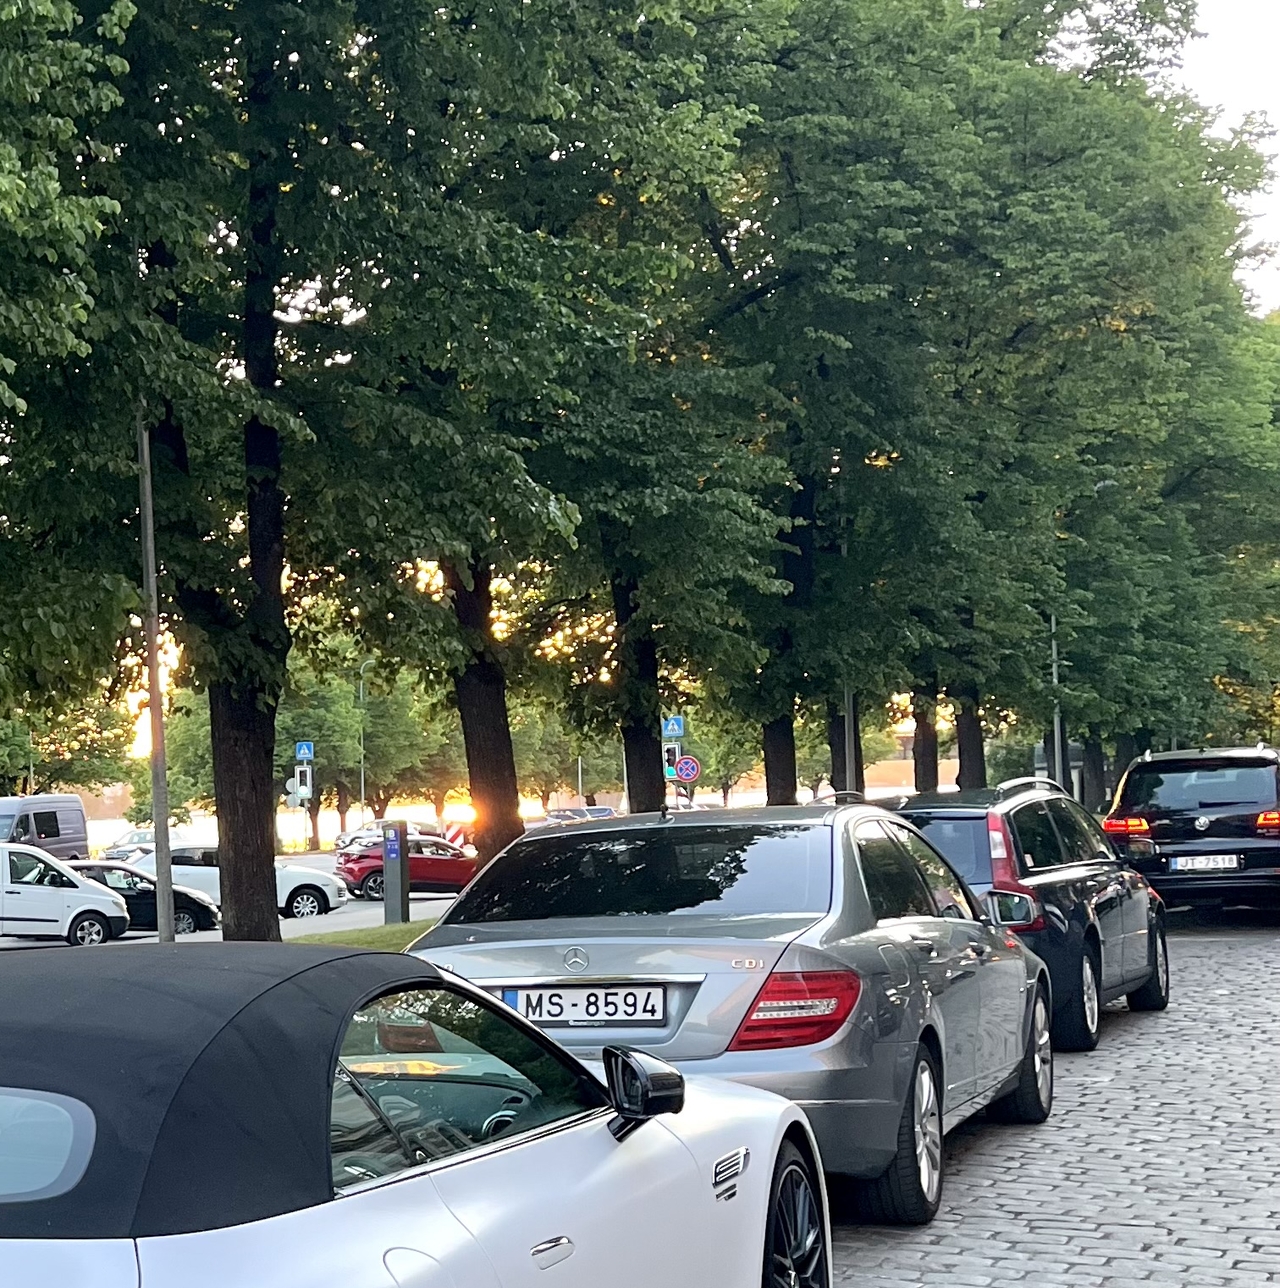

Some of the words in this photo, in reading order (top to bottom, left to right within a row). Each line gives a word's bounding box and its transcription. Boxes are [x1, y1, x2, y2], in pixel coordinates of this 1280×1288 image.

[1180, 856, 1234, 868] JT-7518
[731, 959, 765, 969] CDI
[525, 991, 657, 1018] MS-8594
